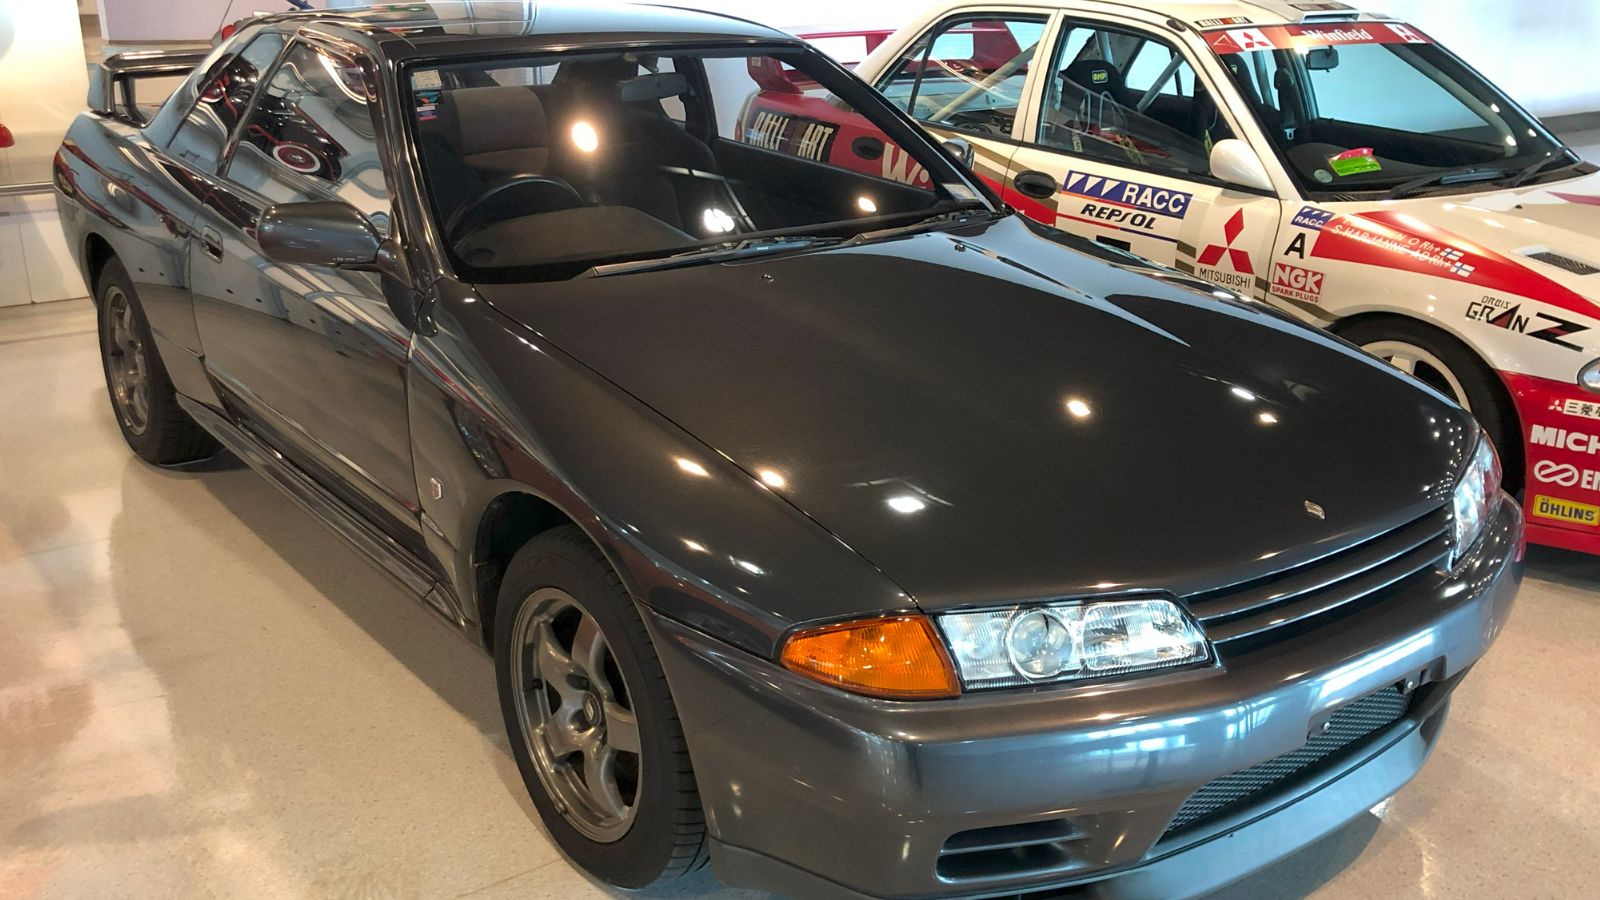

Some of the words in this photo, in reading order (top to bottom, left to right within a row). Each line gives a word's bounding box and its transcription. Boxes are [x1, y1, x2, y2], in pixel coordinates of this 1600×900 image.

[1300, 28, 1374, 41] Winfield
[797, 123, 834, 162] ART
[1121, 182, 1186, 214] RACC
[1080, 203, 1157, 230] REPSOL
[1294, 215, 1325, 228] RACC
[1284, 232, 1306, 259] A
[1199, 267, 1251, 289] MITSUBISHI
[1273, 263, 1322, 294] NGK
[1271, 286, 1294, 297] SPARK
[1295, 291, 1320, 303] PLUGS
[1481, 295, 1511, 310] ORBIS
[1539, 498, 1595, 521] ÖHLINS
